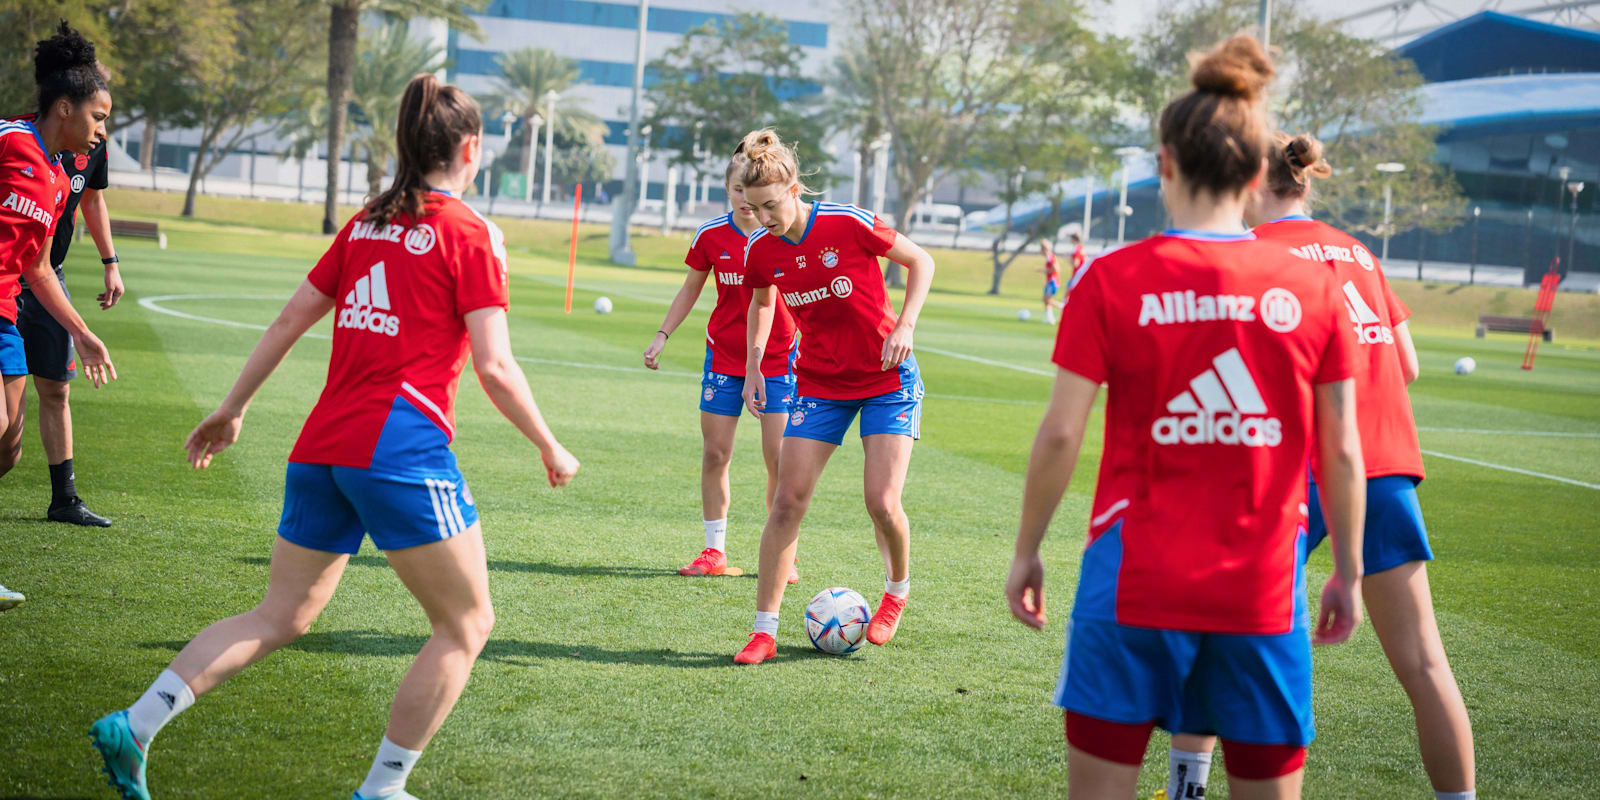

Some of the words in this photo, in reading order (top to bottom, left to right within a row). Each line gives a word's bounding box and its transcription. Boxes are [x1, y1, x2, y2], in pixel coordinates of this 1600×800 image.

[2, 191, 53, 229] Allian
[782, 286, 831, 307] Allianz
[1138, 289, 1256, 326] Allianz
[337, 302, 400, 337] adidas
[1151, 406, 1282, 447] adidas
